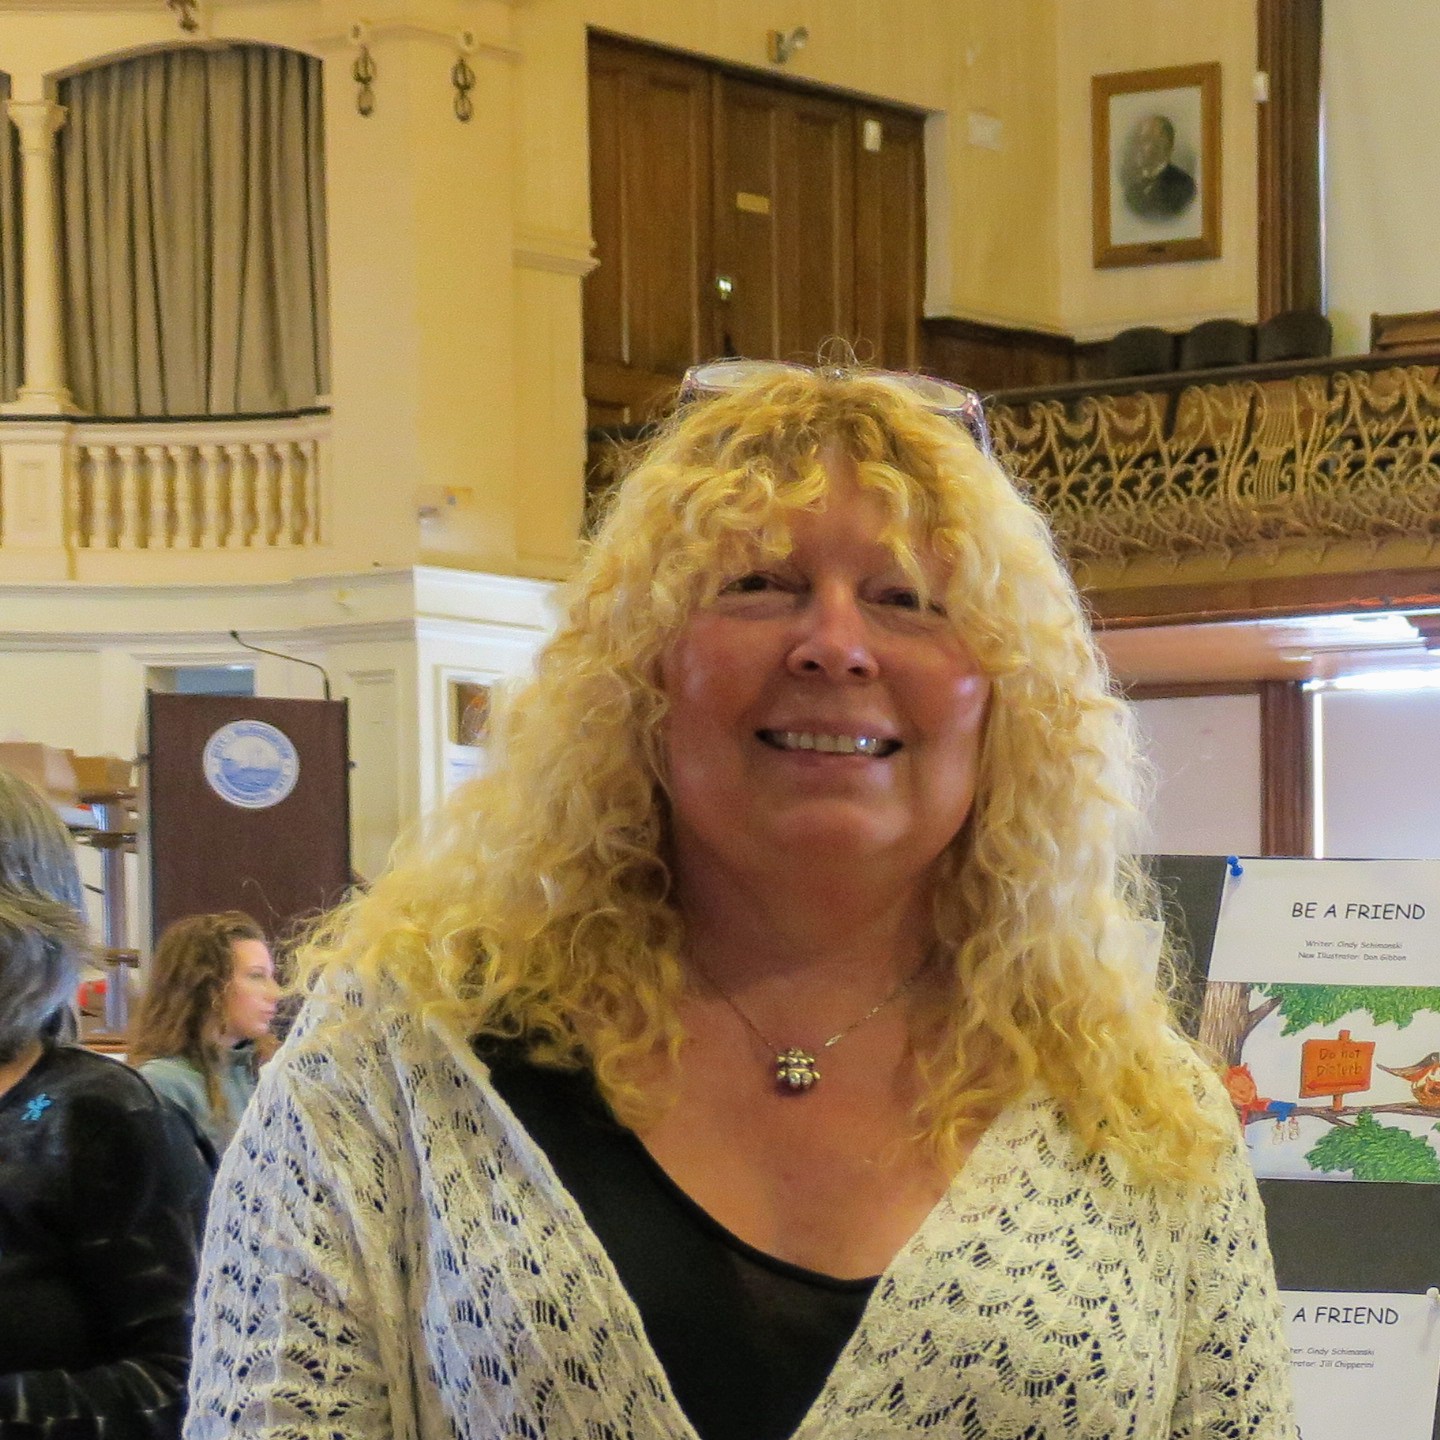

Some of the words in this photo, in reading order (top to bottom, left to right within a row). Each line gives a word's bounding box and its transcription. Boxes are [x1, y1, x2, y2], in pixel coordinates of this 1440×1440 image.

[1292, 902, 1317, 918] BE
[1324, 904, 1337, 917] A
[1345, 903, 1425, 919] FRIEND
[1292, 1307, 1306, 1321] A
[1315, 1306, 1399, 1324] FRIEND
[1307, 1347, 1329, 1356] Cindy
[1332, 1348, 1375, 1356] Schimanski
